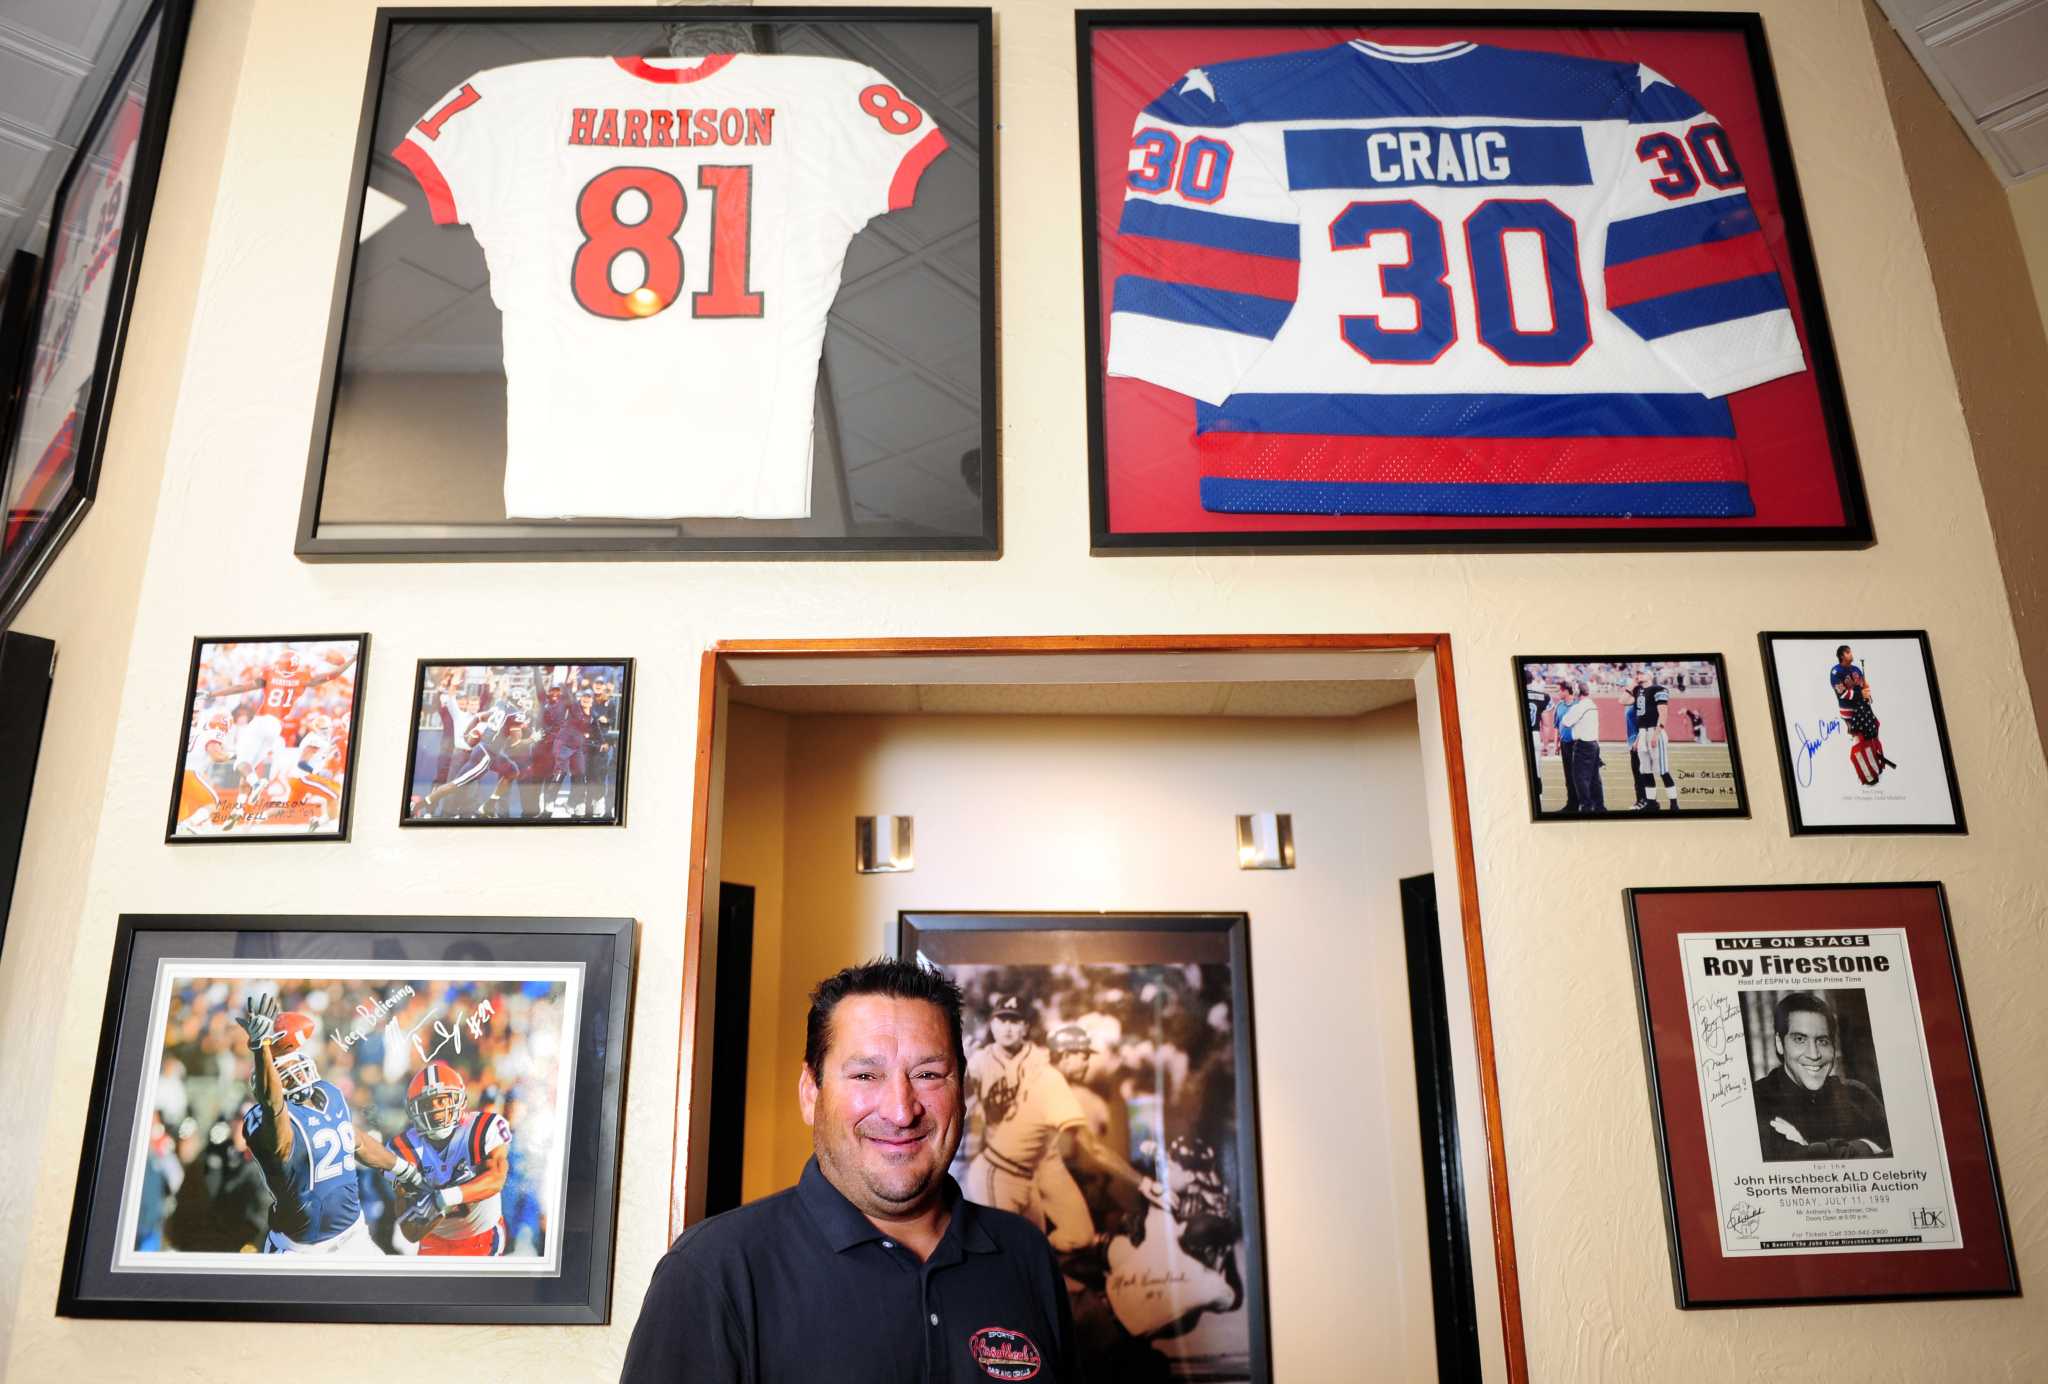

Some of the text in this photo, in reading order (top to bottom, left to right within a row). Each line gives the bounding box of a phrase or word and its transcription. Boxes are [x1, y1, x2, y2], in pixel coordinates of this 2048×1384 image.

[568, 106, 775, 148] HARRISON
[858, 83, 923, 136] 8
[1125, 127, 1234, 205] 30
[1366, 131, 1511, 182] CRAIG
[1636, 122, 1746, 201] 30
[571, 163, 765, 320] 81
[1328, 198, 1594, 367] 30
[268, 688, 294, 707] 81
[1703, 955, 1890, 977] Roy Firestone
[1721, 936, 1865, 949] LIVE ON STAGE
[330, 1028, 368, 1052] Keep
[356, 984, 415, 1026] Believing
[312, 1120, 355, 1182] 29
[1734, 1170, 1927, 1186] John Hirschbeck ALD Celebrity
[1746, 1182, 1919, 1198] Sports Memorabilia Auction
[1824, 1197, 1846, 1205] JULY
